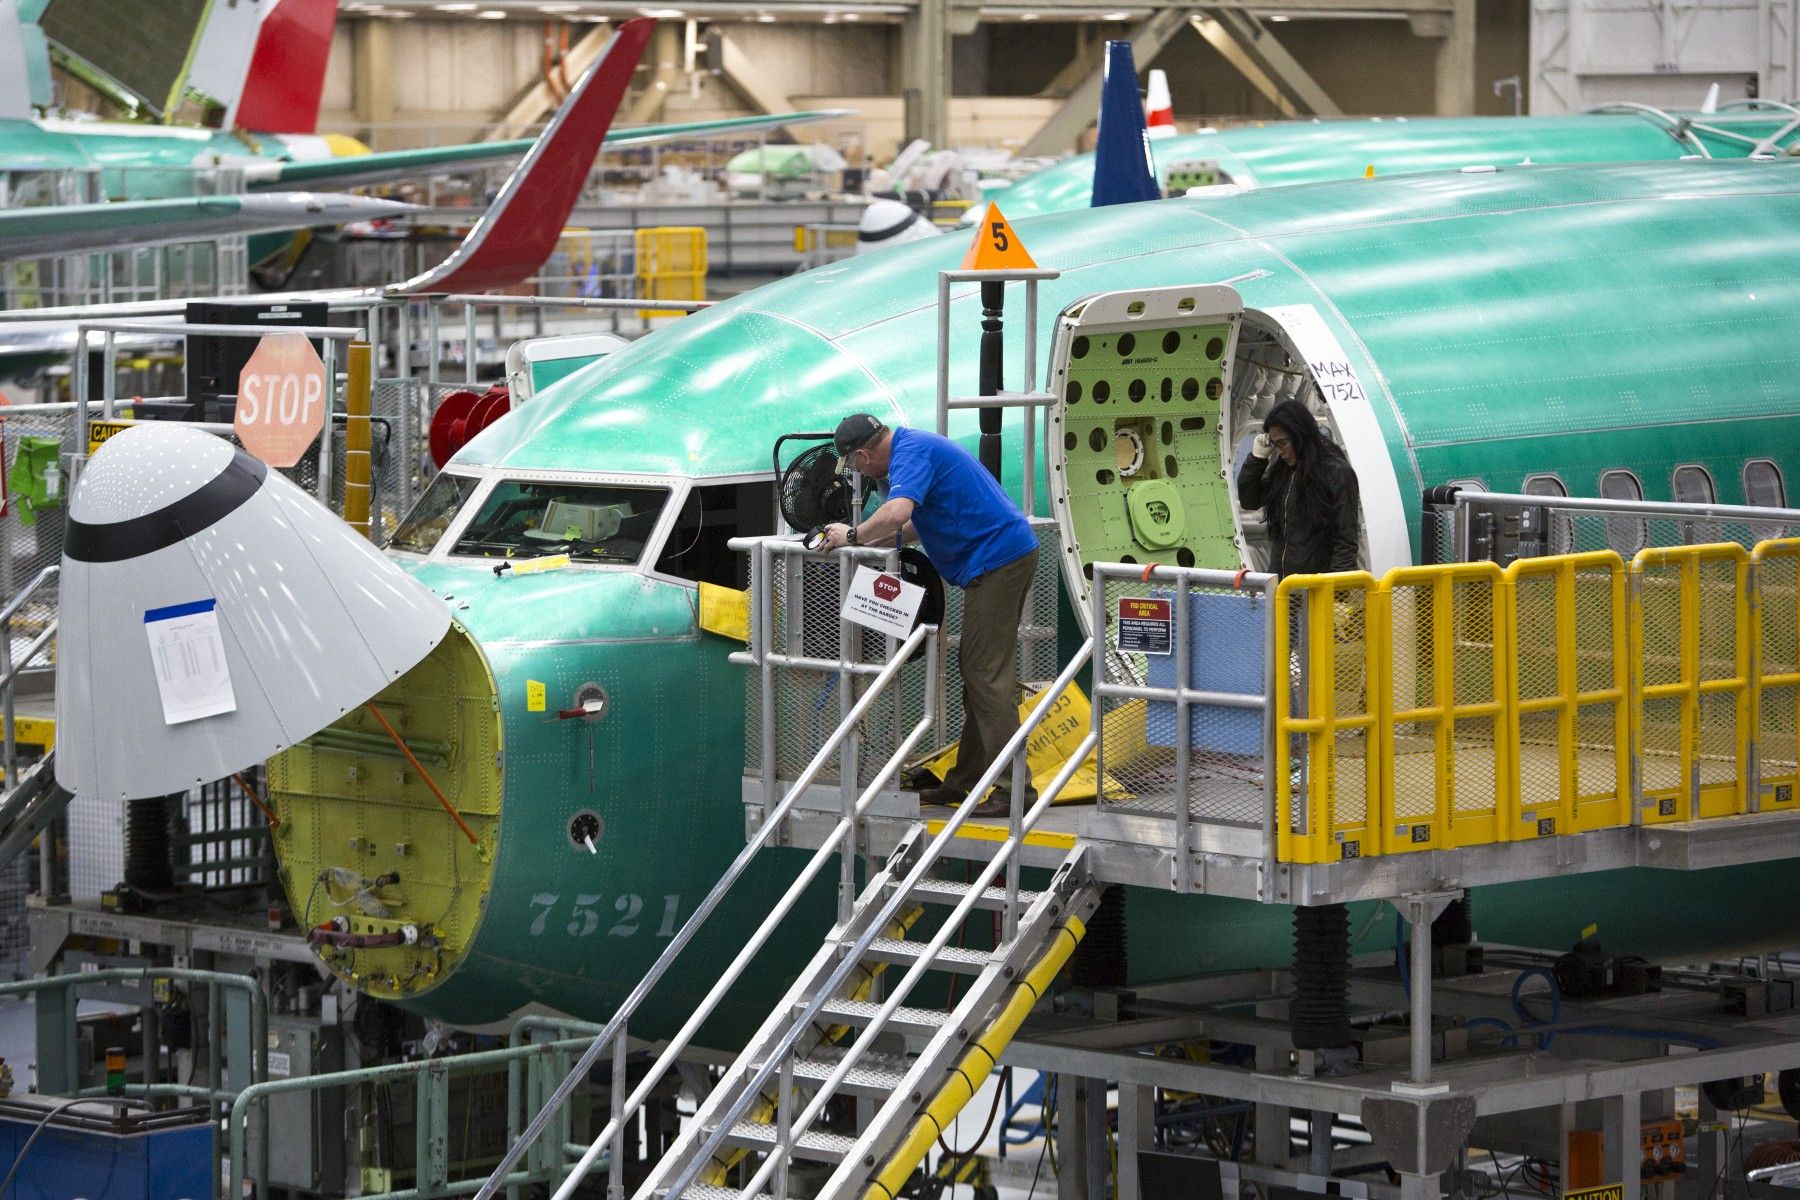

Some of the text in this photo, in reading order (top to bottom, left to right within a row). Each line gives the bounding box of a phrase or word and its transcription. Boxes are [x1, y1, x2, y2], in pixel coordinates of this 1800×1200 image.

[991, 222, 1008, 252] 5
[1311, 361, 1356, 379] MAX
[240, 373, 322, 426] STOP
[1322, 382, 1366, 402] 7521
[879, 582, 898, 592] STOP
[854, 594, 868, 602] HAVE
[868, 599, 879, 607] YOU
[880, 603, 902, 615] CHECKED
[868, 605, 878, 613] THE
[1138, 609, 1150, 617] AREA
[529, 893, 680, 937] 7521
